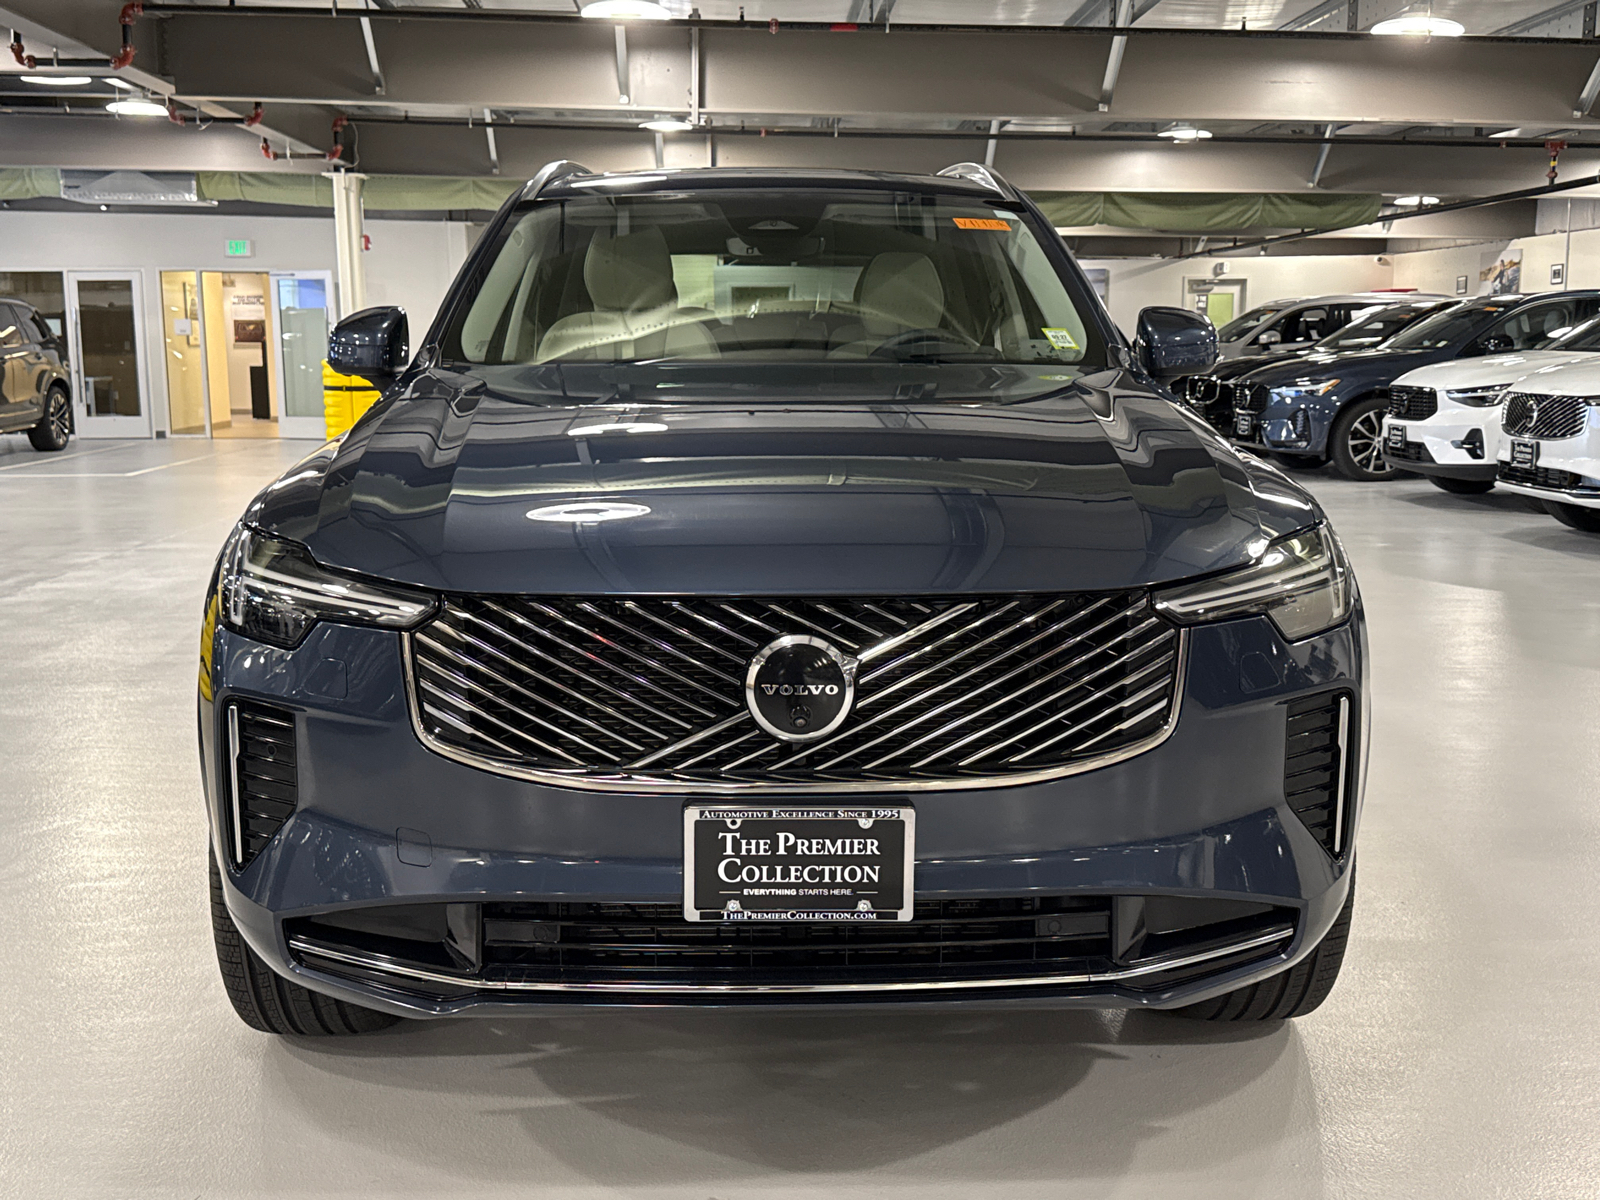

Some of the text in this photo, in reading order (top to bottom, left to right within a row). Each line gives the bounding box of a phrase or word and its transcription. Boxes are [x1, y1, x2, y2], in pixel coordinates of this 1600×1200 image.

[761, 684, 839, 695] VOLVO
[702, 810, 899, 818] AUTOMOTIVE EXCELLENCE SINCE 1995
[718, 832, 881, 855] THE PREMIER
[717, 857, 881, 883] COLLECTION
[743, 888, 797, 896] EVERYTHING
[798, 888, 829, 896] STARTS
[721, 910, 877, 920] THEPREMIERCOLLECTION.COM
